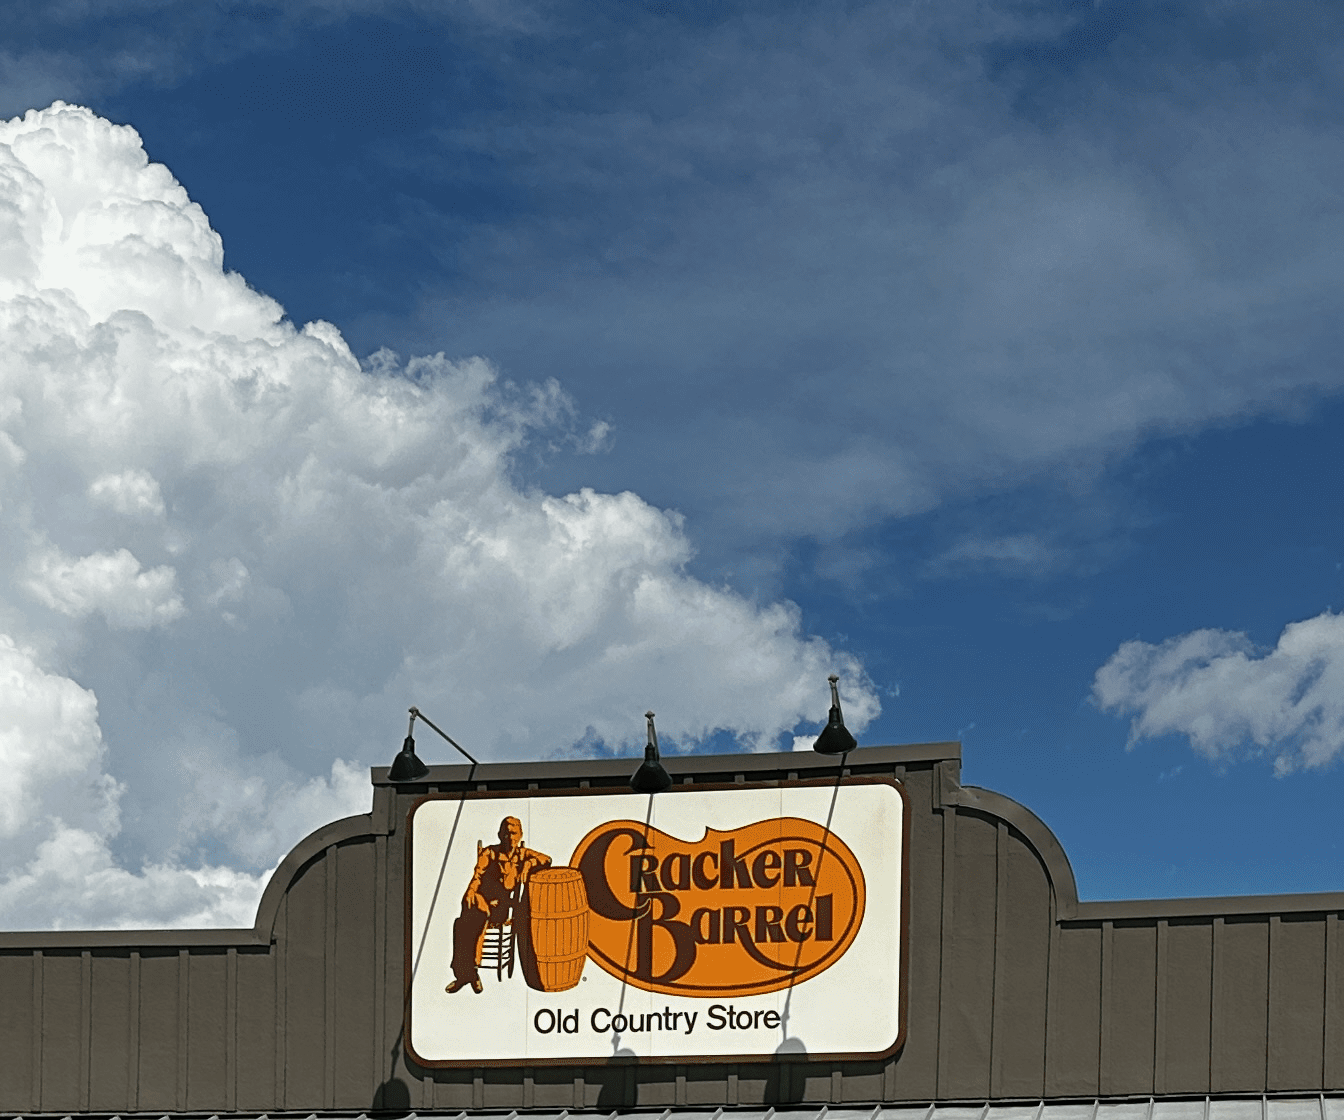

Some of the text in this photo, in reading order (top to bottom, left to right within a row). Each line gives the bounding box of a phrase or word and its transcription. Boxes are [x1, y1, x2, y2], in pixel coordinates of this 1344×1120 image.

[577, 828, 817, 921] Cracker
[635, 890, 833, 984] Barrel
[533, 1004, 782, 1035] Old Country Store
